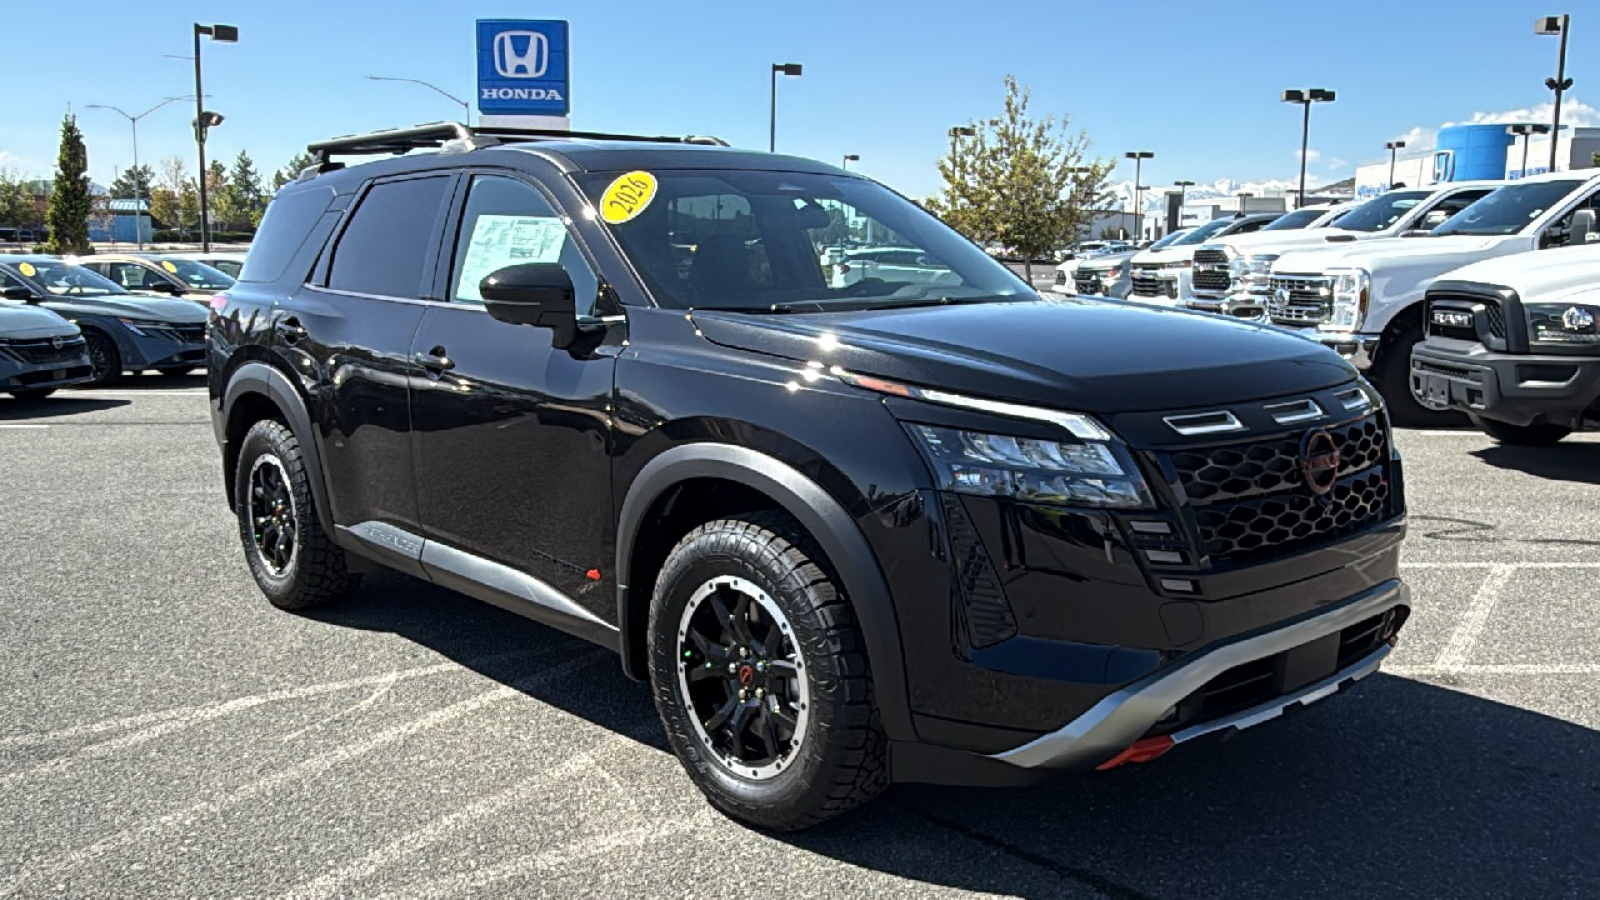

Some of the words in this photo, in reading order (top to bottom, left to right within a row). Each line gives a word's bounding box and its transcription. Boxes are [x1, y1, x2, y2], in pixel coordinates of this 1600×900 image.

[481, 88, 564, 101] HONDA
[609, 177, 649, 215] 2026
[1434, 312, 1470, 326] RAM
